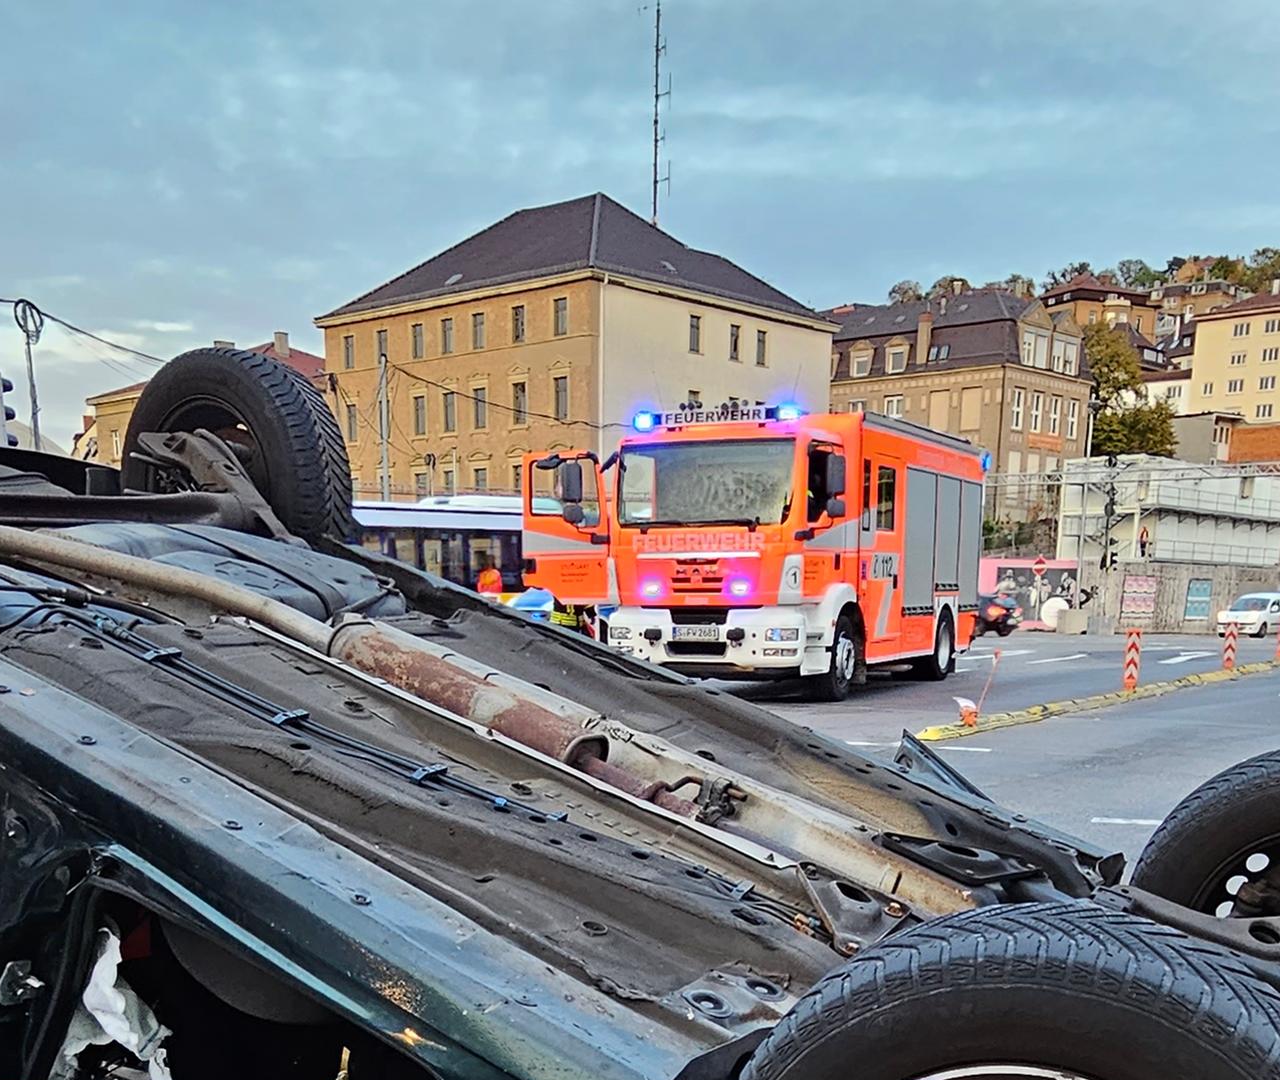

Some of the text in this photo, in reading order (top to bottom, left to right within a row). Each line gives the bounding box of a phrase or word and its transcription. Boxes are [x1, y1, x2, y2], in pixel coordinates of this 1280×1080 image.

[665, 408, 762, 425] FEUERWEHR
[632, 532, 765, 552] FEUERWEHR
[881, 556, 893, 577] 112
[791, 571, 798, 584] 1
